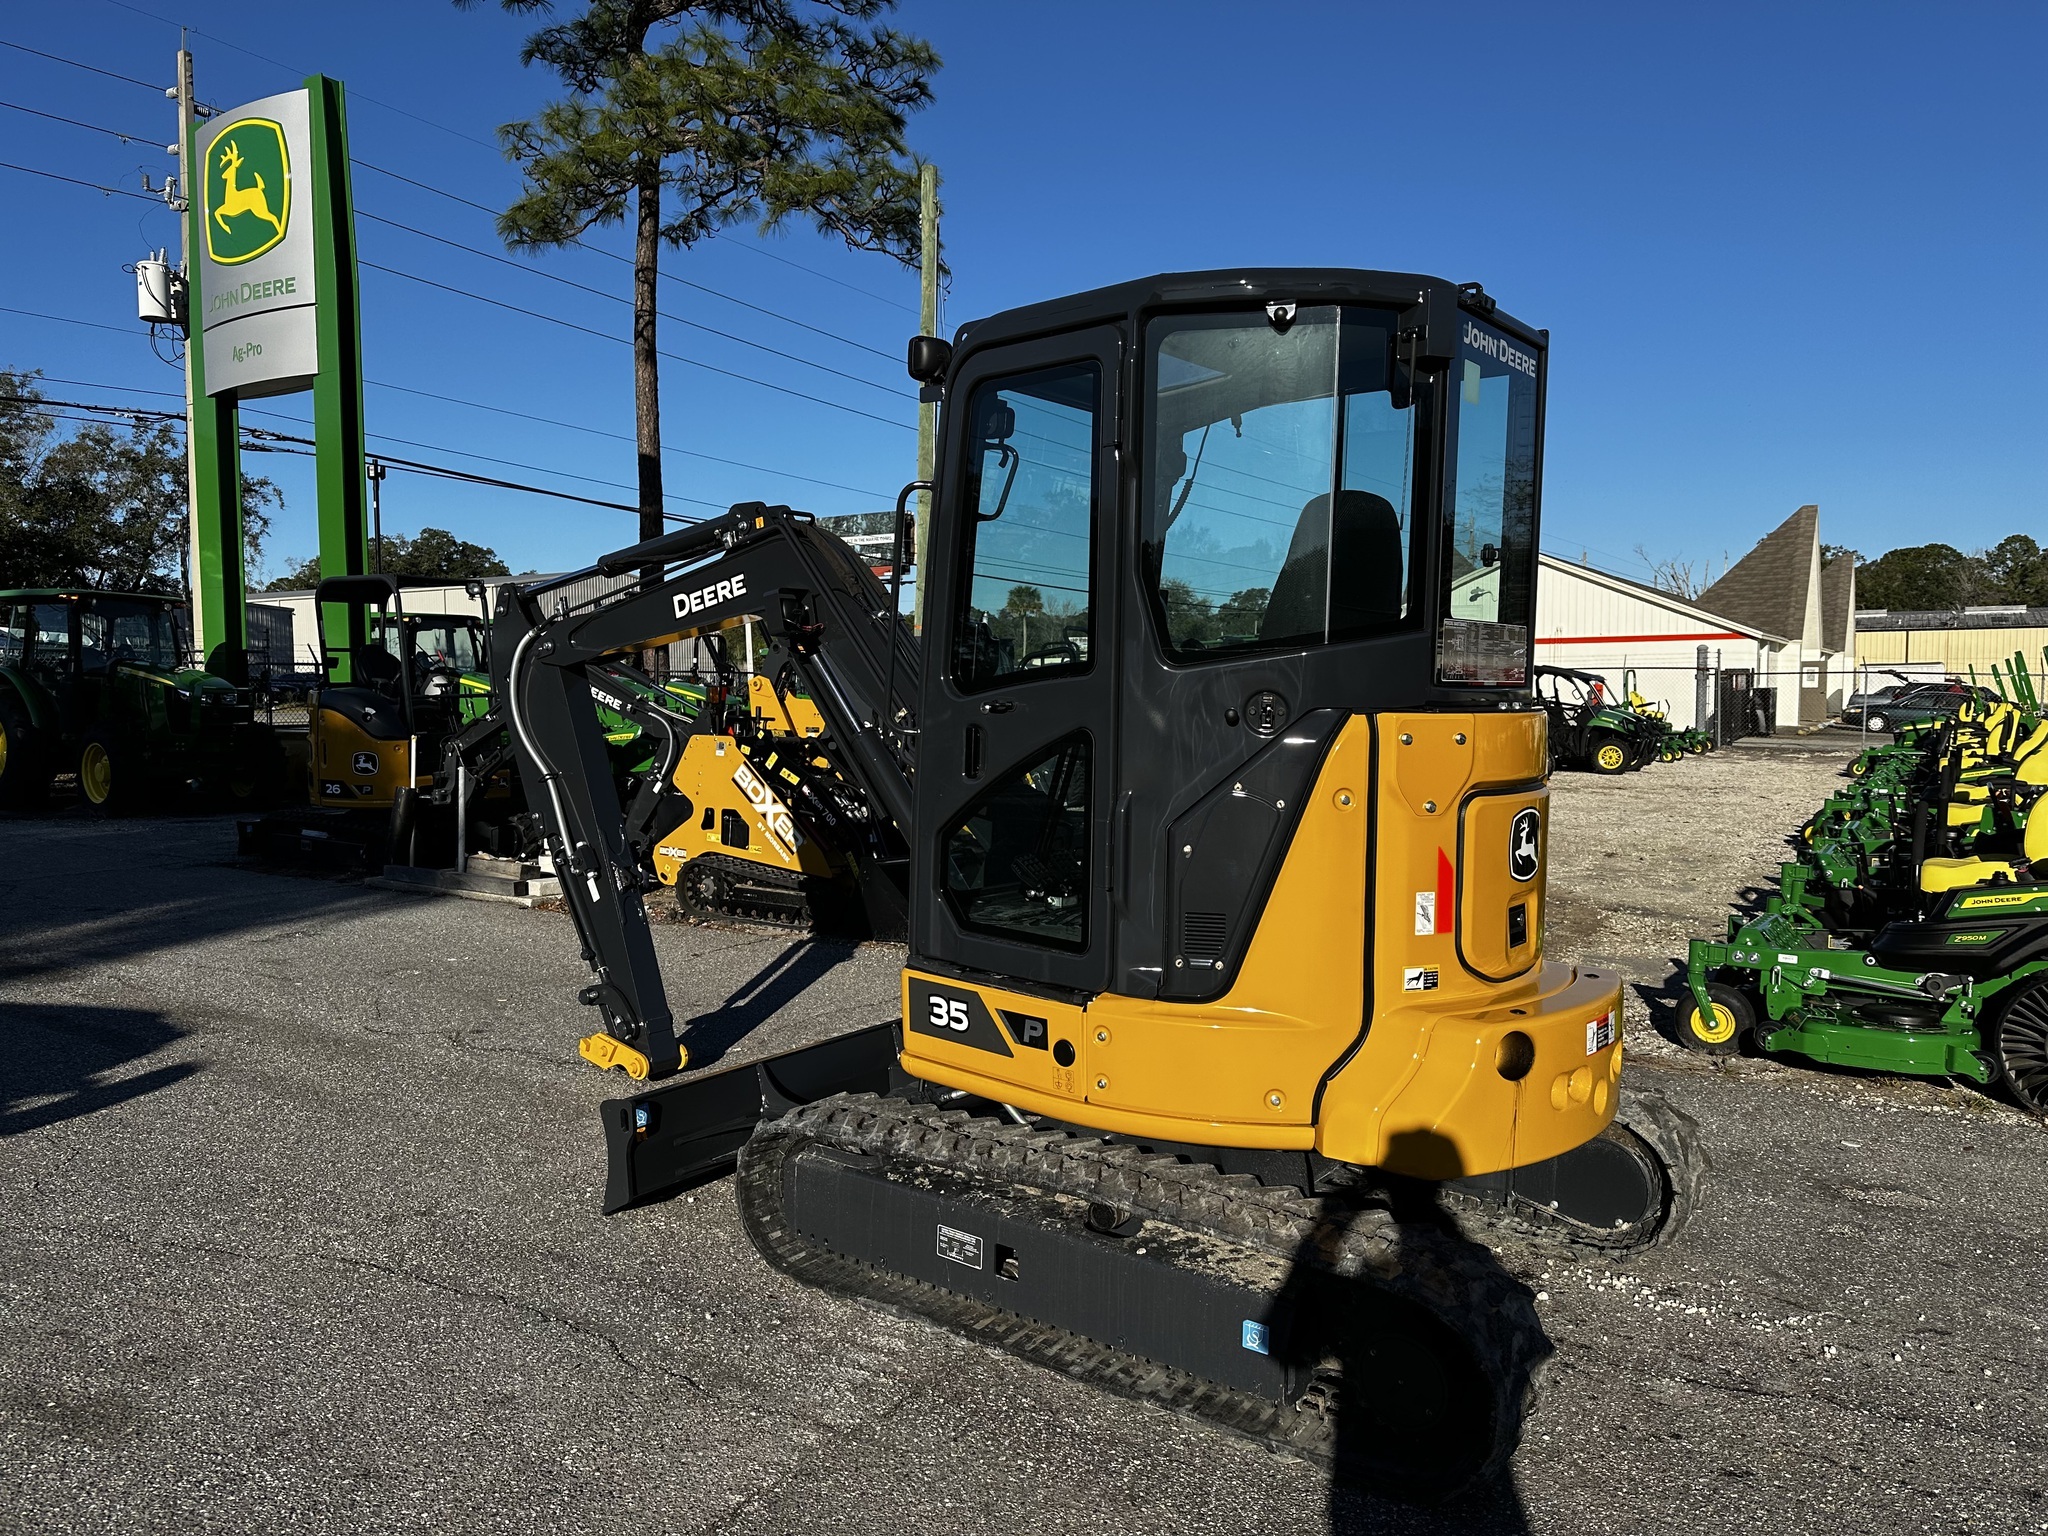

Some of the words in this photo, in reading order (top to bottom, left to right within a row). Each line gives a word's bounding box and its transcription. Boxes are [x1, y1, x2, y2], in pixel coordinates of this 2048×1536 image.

[209, 288, 239, 313] JOHN
[240, 276, 296, 303] DEERE
[232, 342, 262, 362] Ag-Pro
[1463, 320, 1497, 359] JOHN
[1499, 338, 1537, 378] DEERE
[672, 573, 747, 619] DEERE
[589, 684, 622, 711] EERE
[325, 783, 341, 794] 26
[362, 786, 371, 794] P
[733, 763, 803, 853] BOXER
[822, 808, 836, 826] 700
[756, 821, 767, 832] BY
[659, 846, 687, 857] BOXER
[929, 995, 969, 1032] 35
[1023, 1018, 1043, 1043] P
